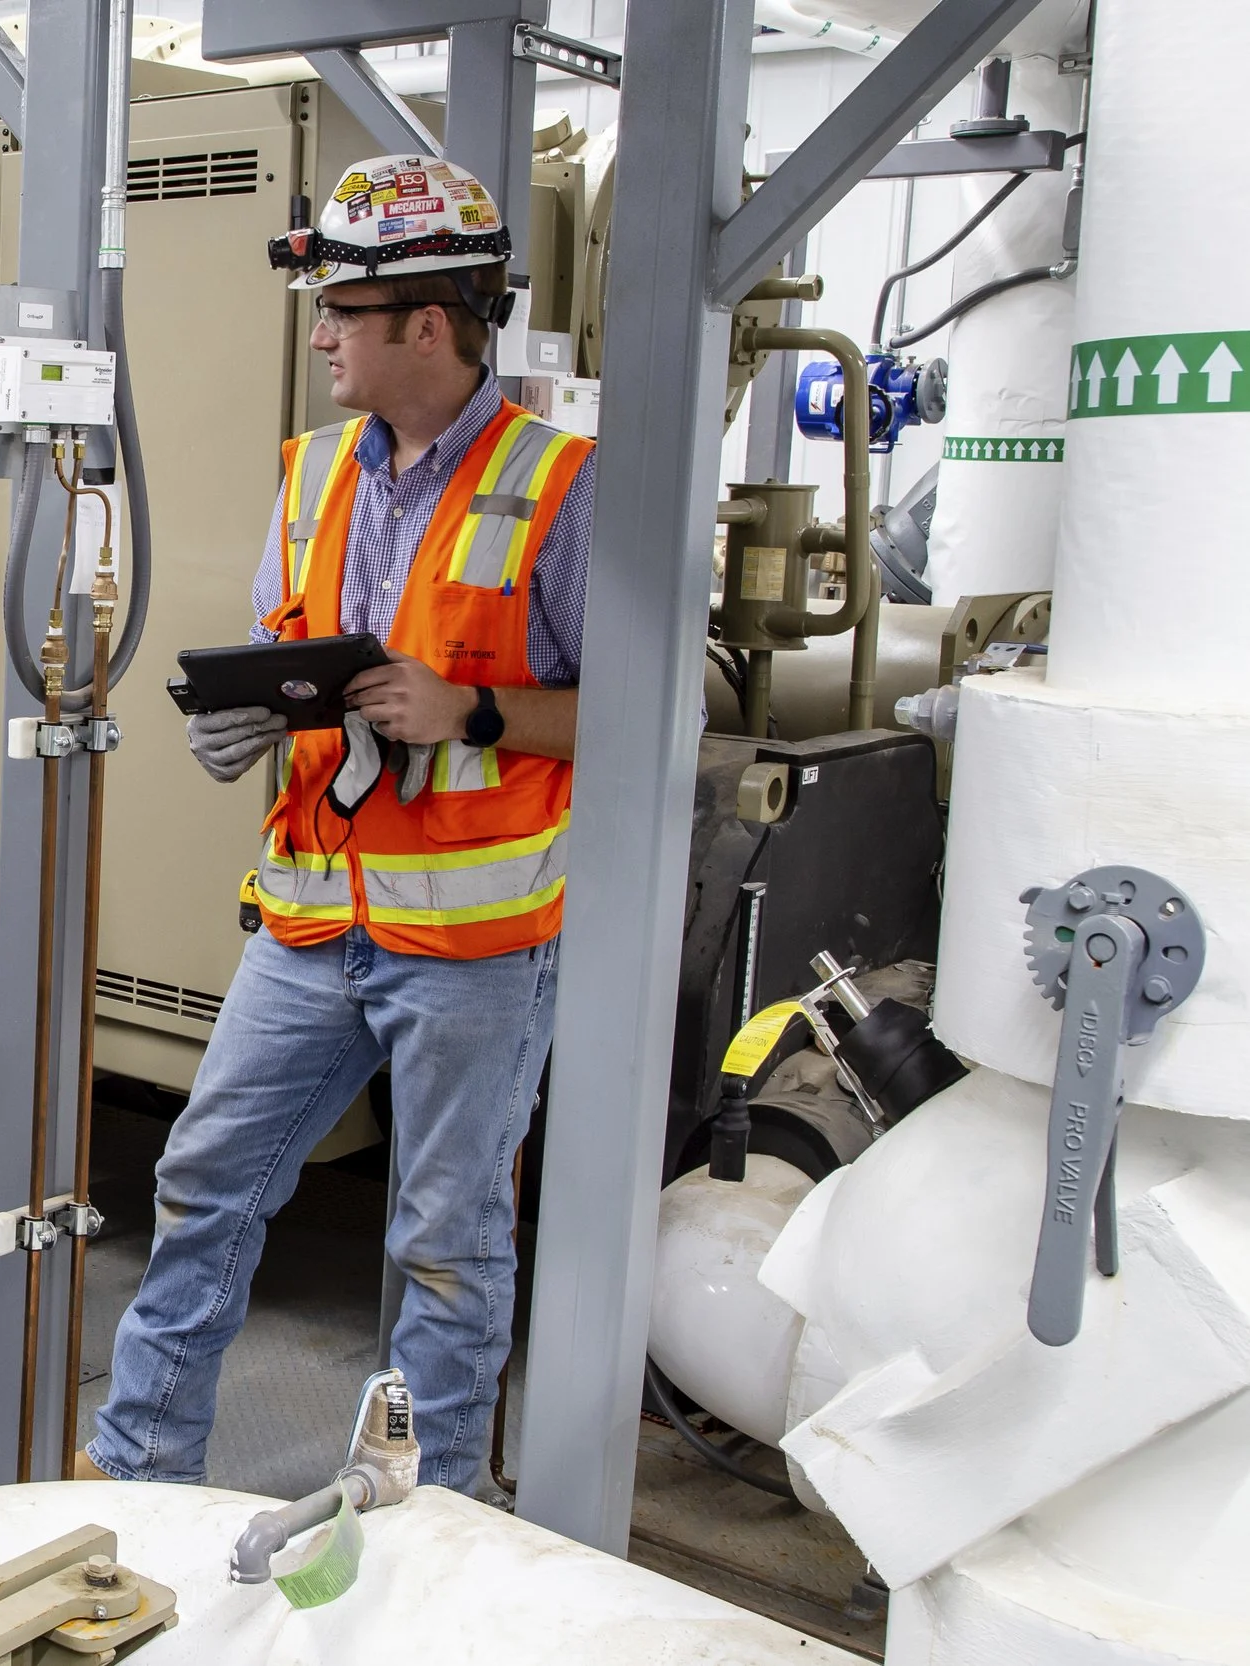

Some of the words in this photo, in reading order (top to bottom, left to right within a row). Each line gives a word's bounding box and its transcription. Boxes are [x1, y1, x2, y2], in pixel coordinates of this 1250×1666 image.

[398, 174, 424, 186] 150
[460, 210, 480, 223] 2012
[444, 650, 469, 659] SAFETY
[470, 651, 496, 660] WORKS
[803, 769, 817, 781] LIFT
[739, 1034, 769, 1048] CAUTION
[1064, 1101, 1090, 1151] PRO
[1054, 1156, 1082, 1225] VALVE
